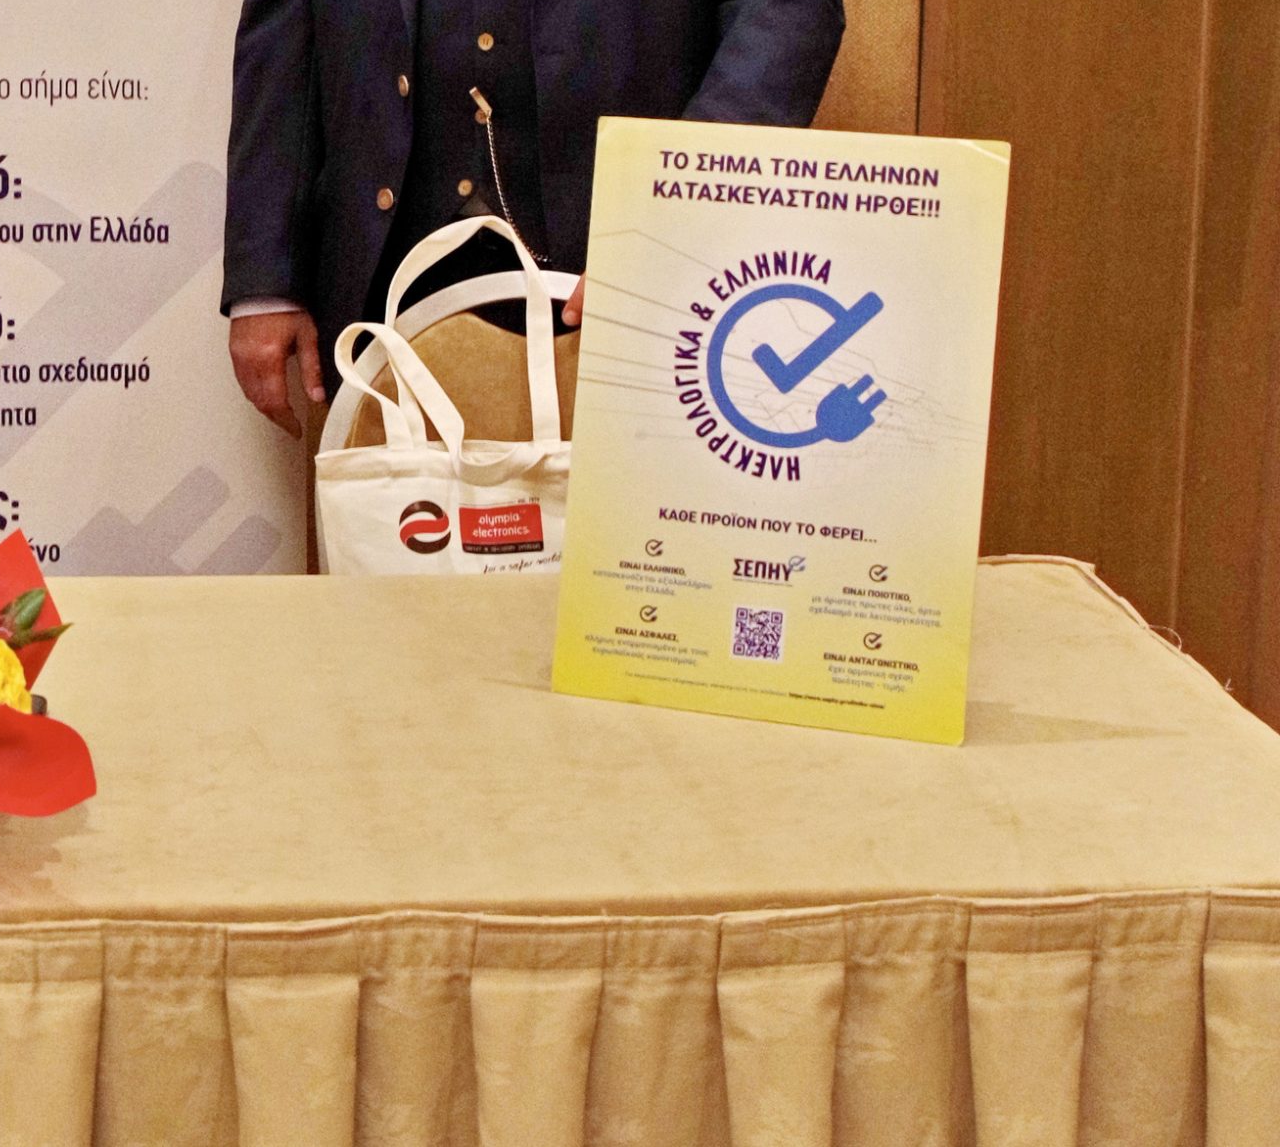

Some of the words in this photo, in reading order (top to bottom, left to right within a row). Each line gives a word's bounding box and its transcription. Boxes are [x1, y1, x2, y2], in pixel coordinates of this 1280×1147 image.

[19, 73, 78, 106] σήμα
[87, 70, 149, 101] είναι:
[660, 151, 689, 169] ΤΟ
[697, 154, 763, 175] ΣΗΜΑ
[770, 159, 818, 179] ΤΩΝ
[825, 162, 939, 187] ΕΛΛΗΝΩΝ
[652, 180, 848, 211] ΚΑΤΑΣΚΕΥΑΣΤΩΝ
[855, 196, 941, 218] ΗΡΘΕ!!!
[32, 221, 81, 243] στην
[90, 216, 170, 244] Ελλάδα
[708, 251, 832, 302] ΕΛΛΗΝΙΚΑ
[690, 302, 715, 321] &
[38, 357, 150, 388] σχεδιασμό
[675, 330, 801, 481] ΗΛΕΚΤΡΟΛΟΓΙΚΑ
[472, 526, 529, 537] electronics
[478, 513, 520, 525] olympia
[659, 508, 697, 523] ΚΑΘΕ
[701, 512, 757, 530] ΠΡΟΪΟΝ
[762, 519, 791, 533] ΠΟΥ
[797, 522, 815, 535] ΤΟ
[820, 526, 877, 543] ΦΕΡΕΙ...
[733, 558, 793, 581] ΣΕΠΗΥ
